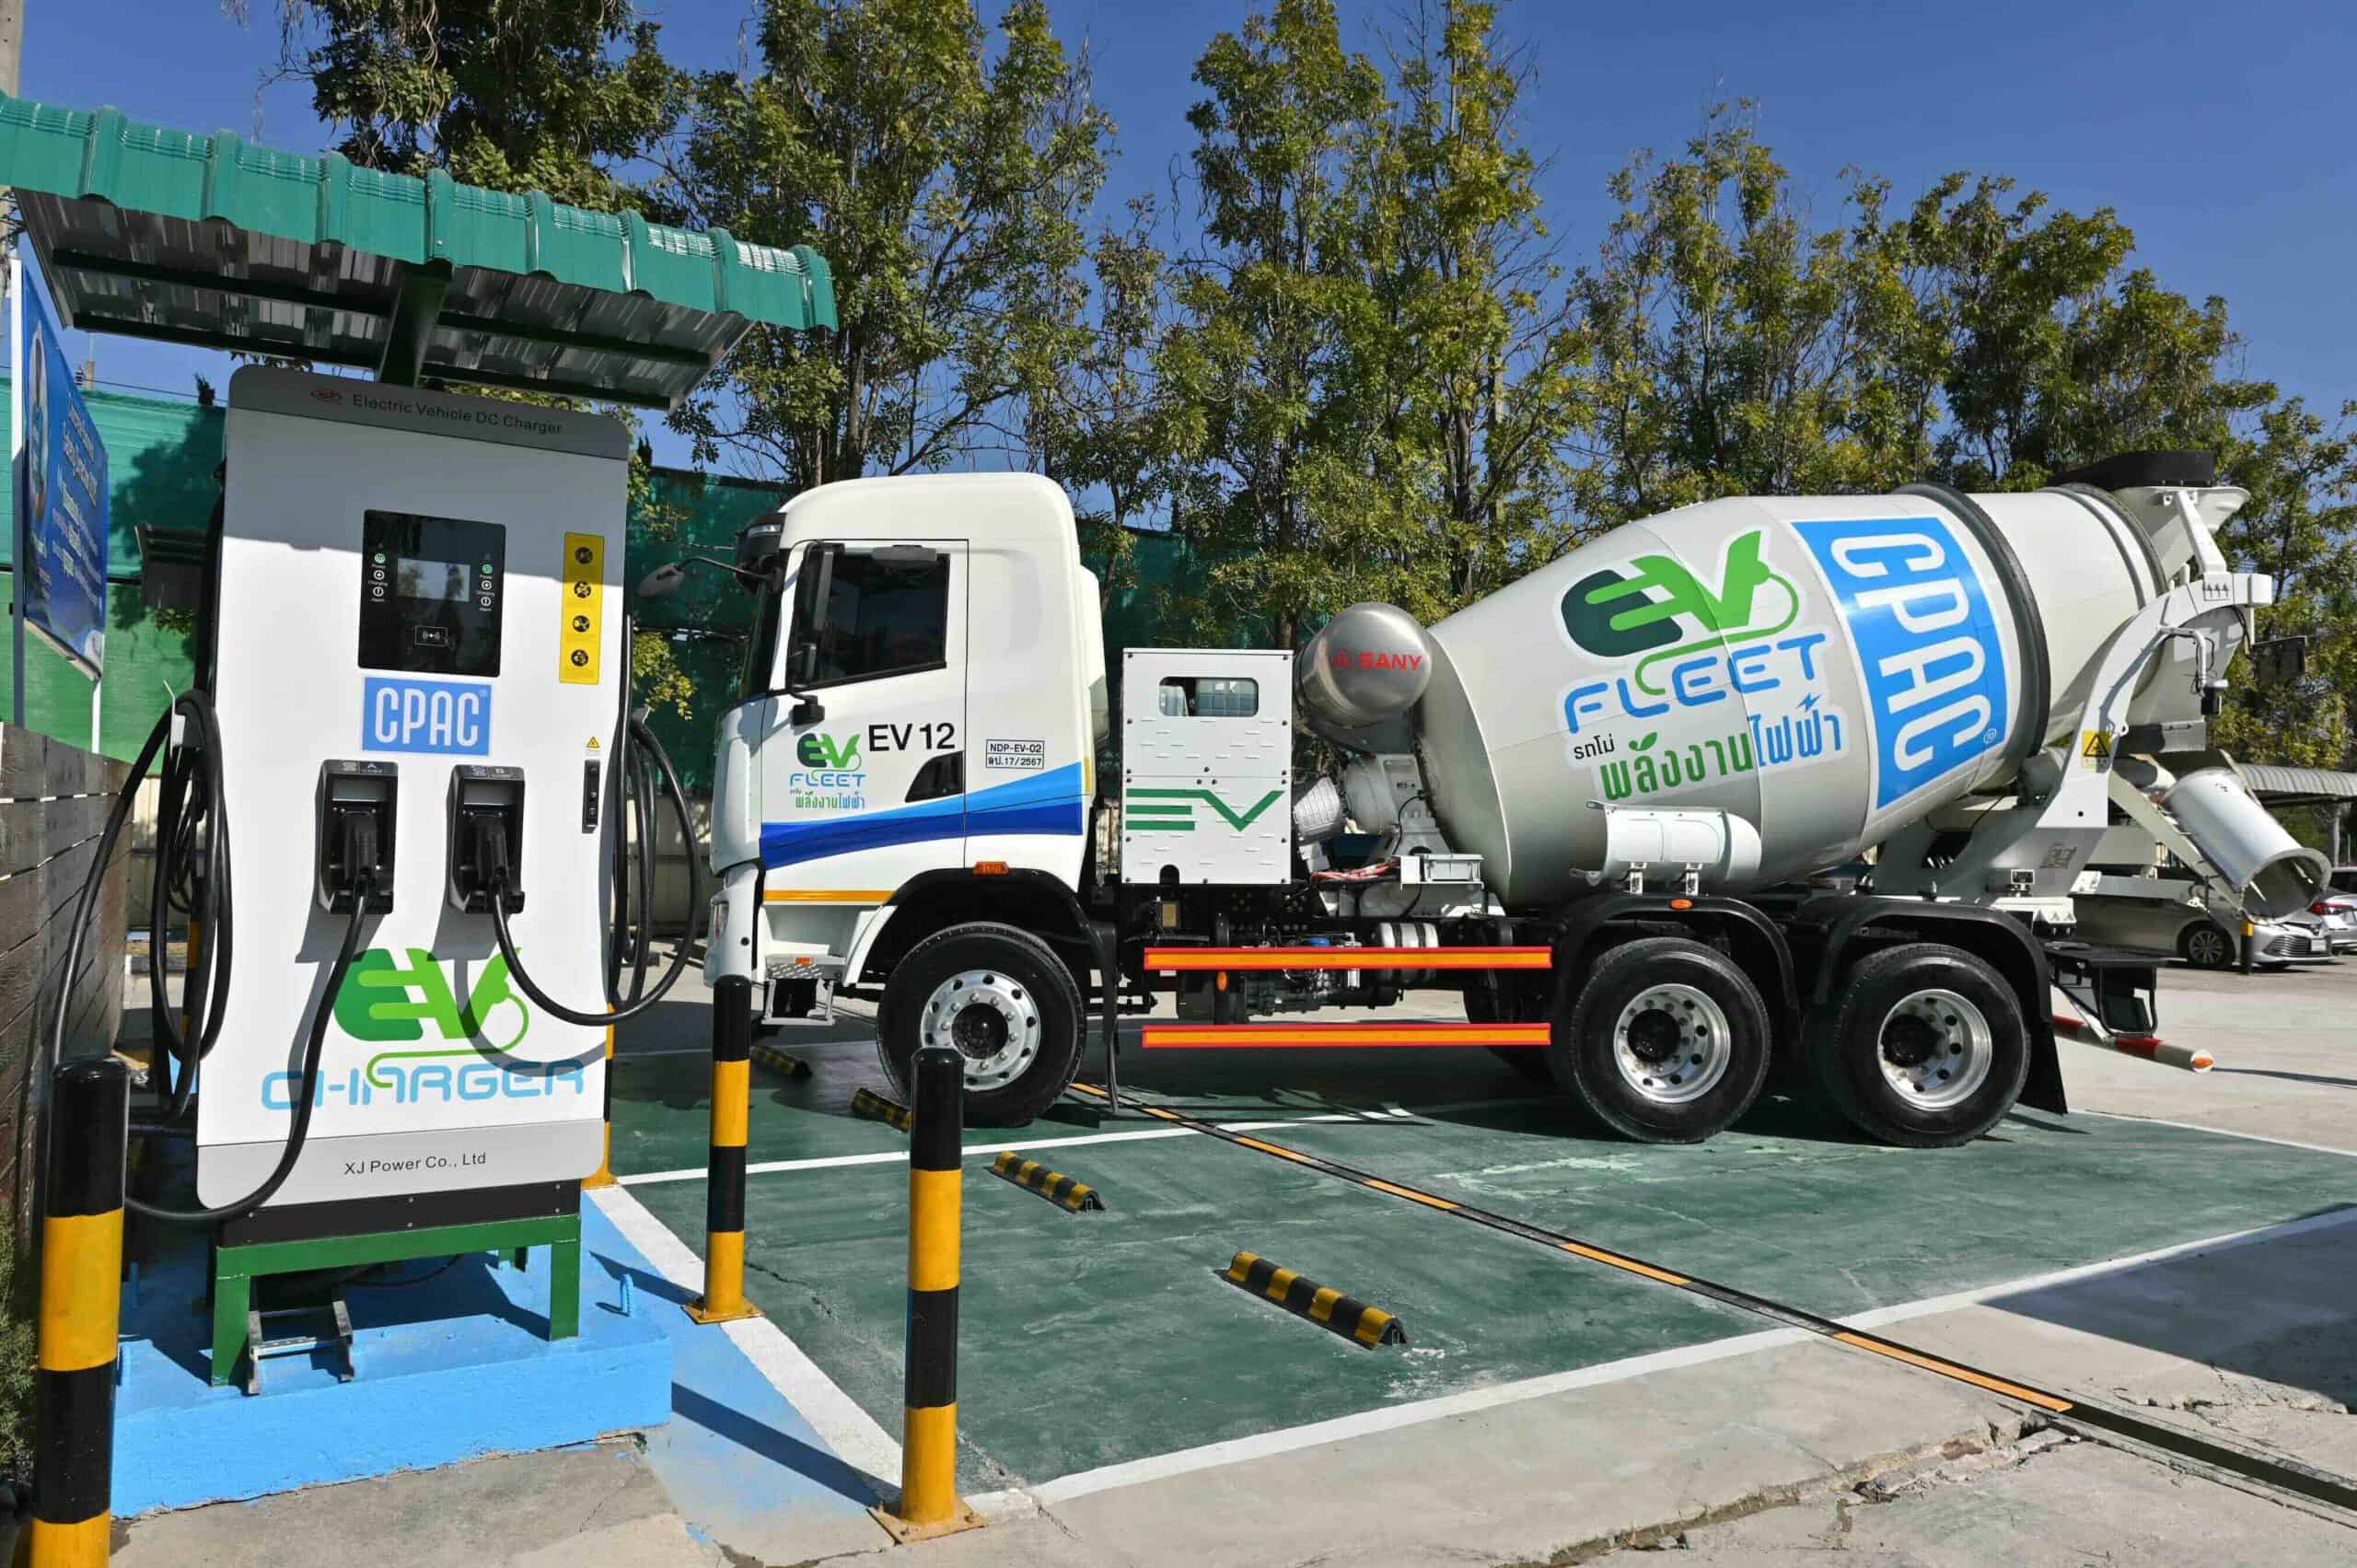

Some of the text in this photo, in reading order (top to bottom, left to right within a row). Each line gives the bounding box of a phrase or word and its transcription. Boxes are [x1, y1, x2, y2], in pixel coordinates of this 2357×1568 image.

[354, 393, 412, 413] Electric
[415, 401, 472, 423] Vehicle
[476, 412, 500, 425] DC
[504, 414, 563, 435] Charger
[1561, 530, 1798, 656] EV
[1358, 650, 1422, 671] SANY
[1830, 533, 1991, 772] CPAC
[1564, 633, 1826, 734] FLEET
[375, 687, 480, 748] CPAC
[797, 733, 862, 768] EV
[868, 723, 956, 751] EV 12
[990, 743, 1042, 753] NDP-EV-02
[1573, 734, 1615, 760] รถโม่
[790, 773, 866, 787] FLEET
[333, 947, 528, 1041] EV
[344, 1152, 486, 1176] XJ Power Co., Ltd
